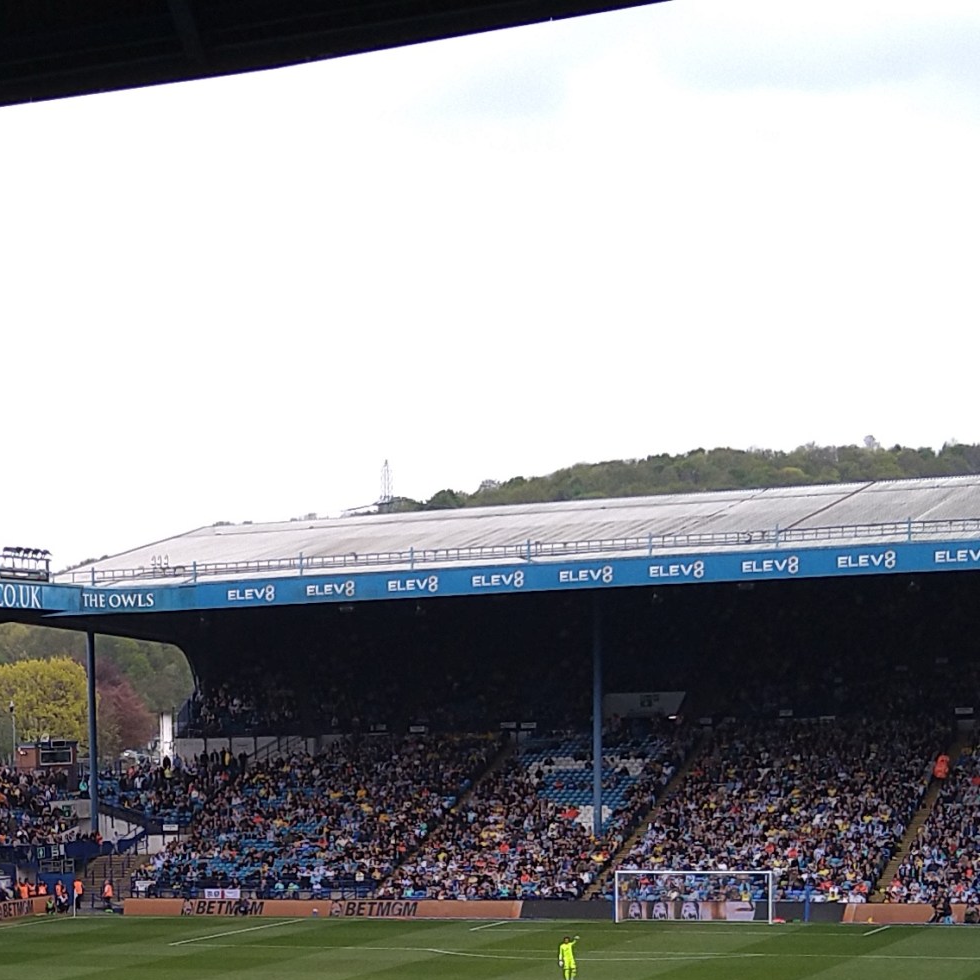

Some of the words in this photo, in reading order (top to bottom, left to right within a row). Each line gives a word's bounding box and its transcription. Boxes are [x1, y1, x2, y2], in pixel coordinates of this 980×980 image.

[742, 555, 799, 574] ELEV8
[837, 550, 896, 569] ELEV8
[559, 565, 613, 583] ELEV8
[649, 560, 705, 579] ELEV8
[388, 575, 438, 592] ELEV8
[472, 570, 524, 588] ELEV8
[227, 585, 275, 601] ELEV8
[306, 580, 355, 597] ELEV8
[83, 593, 106, 608] THE
[109, 593, 154, 608] OWLS
[195, 901, 264, 916] BETMM
[345, 901, 418, 916] BETMGM
